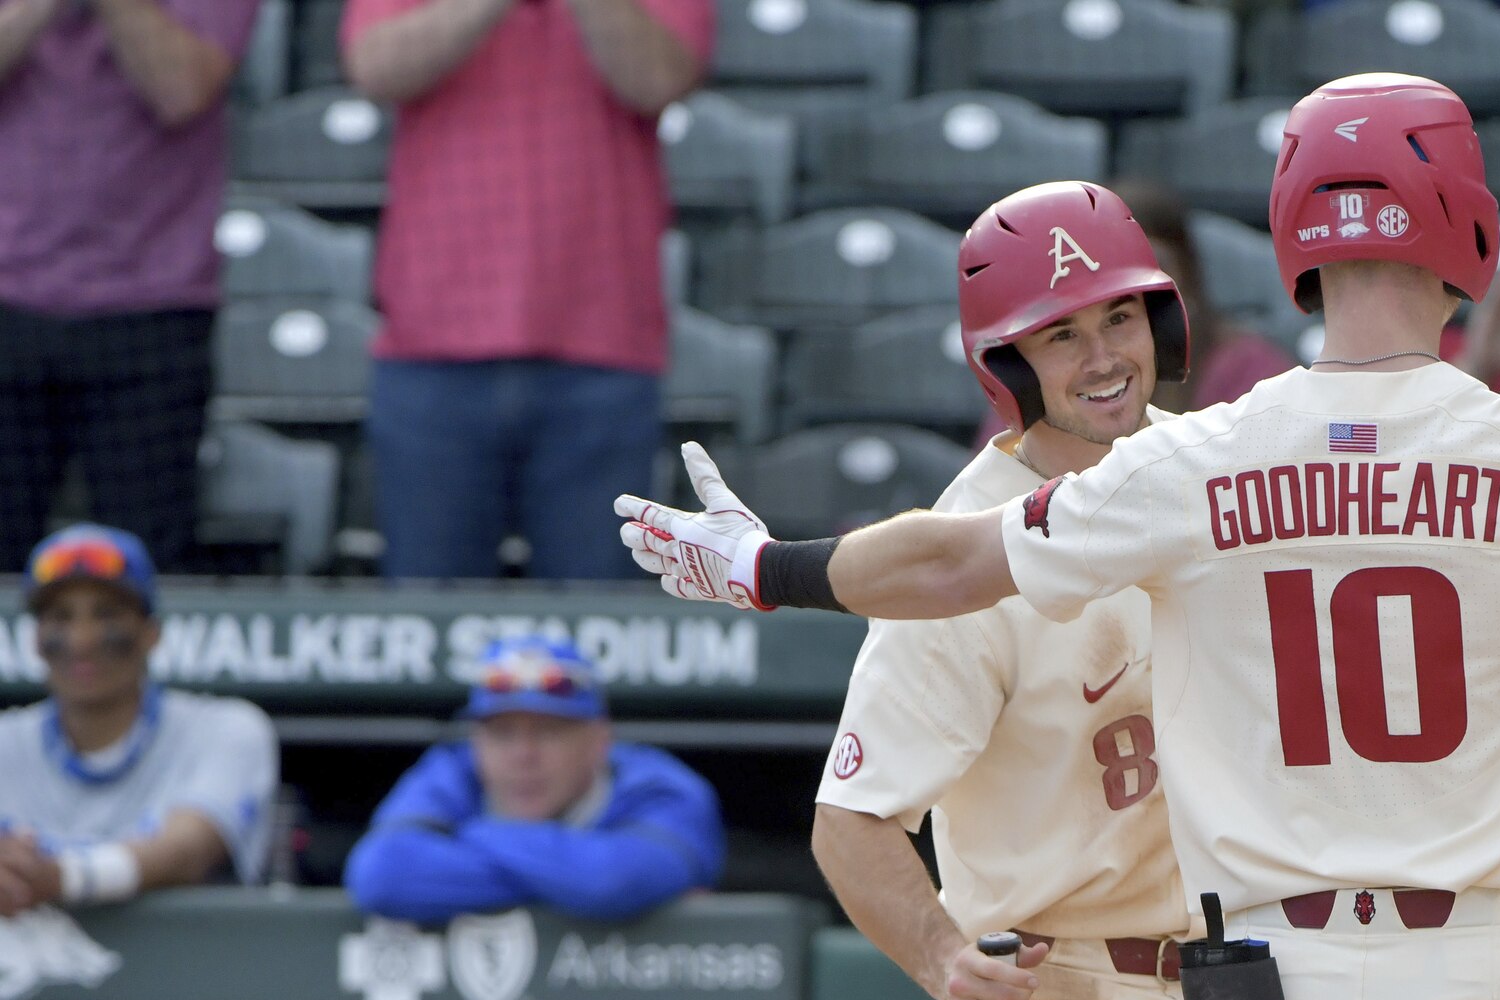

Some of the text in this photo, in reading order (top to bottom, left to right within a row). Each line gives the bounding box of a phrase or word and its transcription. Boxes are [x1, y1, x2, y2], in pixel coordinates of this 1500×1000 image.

[1298, 225, 1330, 241] WPS
[1340, 193, 1363, 219] 10
[1378, 206, 1407, 236] SEC
[1048, 226, 1100, 289] A
[148, 614, 435, 684] WALKER
[1264, 566, 1468, 766] 10
[1093, 714, 1158, 811] 8
[547, 931, 784, 990] Arkansas
